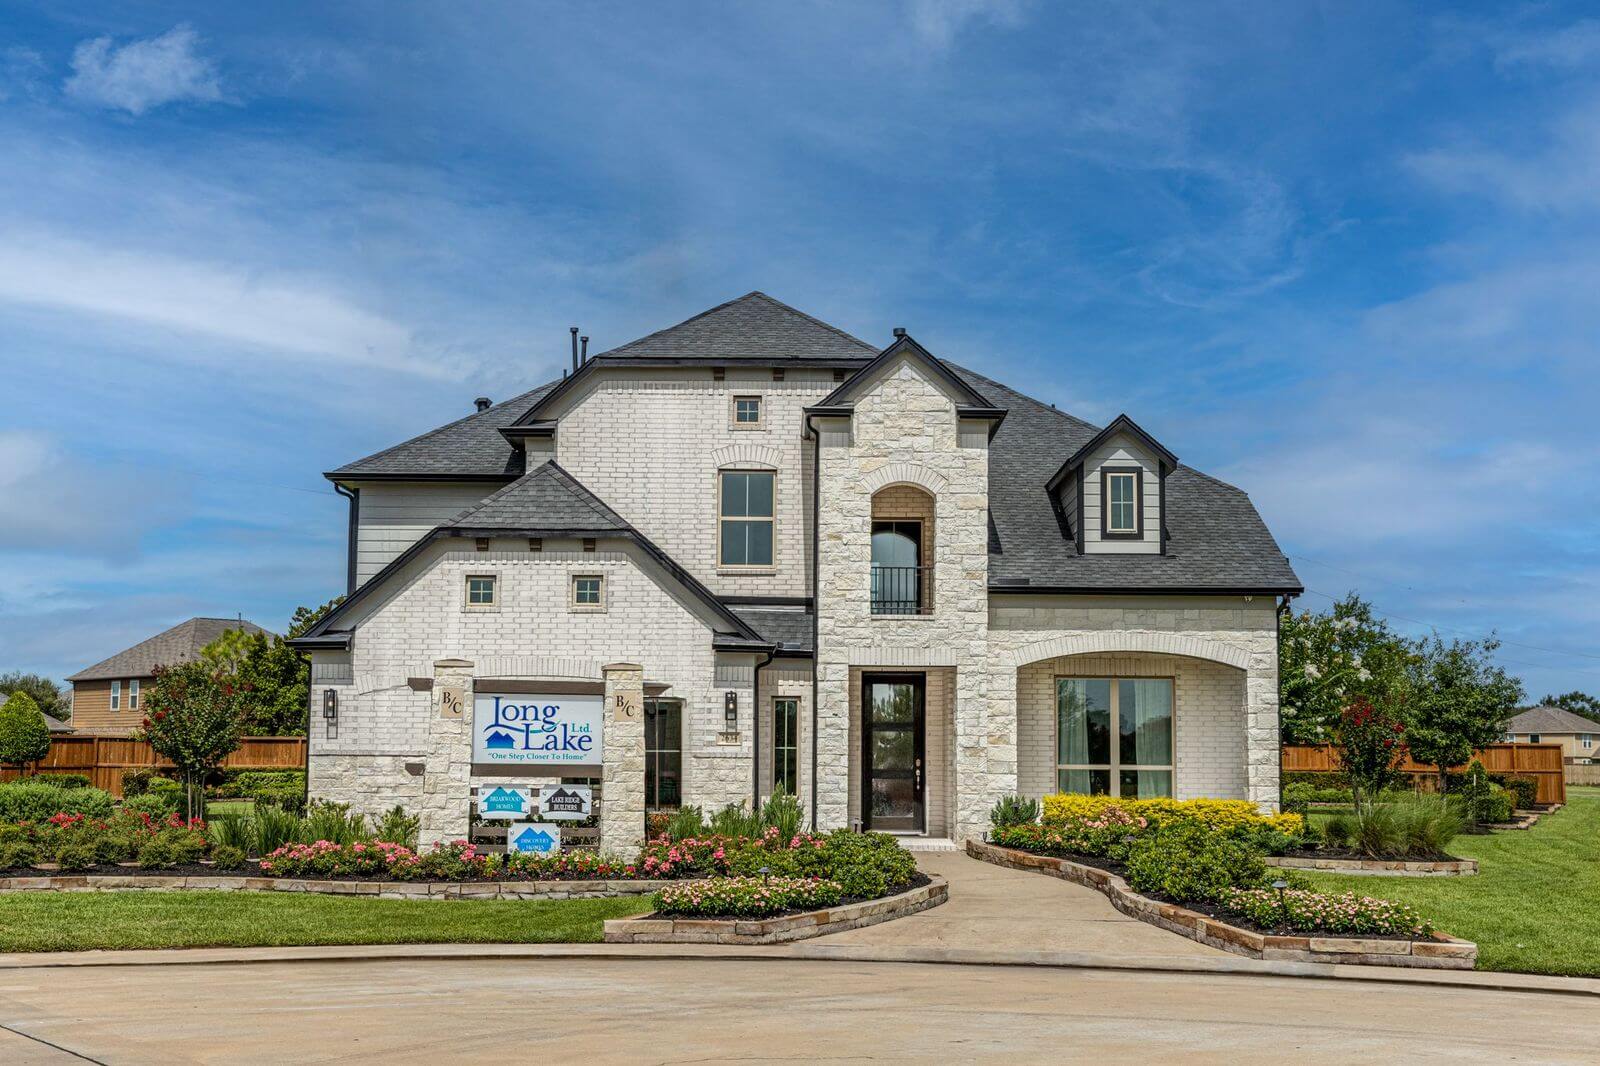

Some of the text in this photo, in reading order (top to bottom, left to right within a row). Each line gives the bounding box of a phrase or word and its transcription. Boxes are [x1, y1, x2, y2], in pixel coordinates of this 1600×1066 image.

[484, 696, 560, 733] Long
[571, 723, 593, 733] Ltd.
[521, 723, 593, 752] Lake
[508, 752, 525, 761] Step
[526, 752, 549, 760] Closer
[553, 803, 578, 811] BUILDERS
